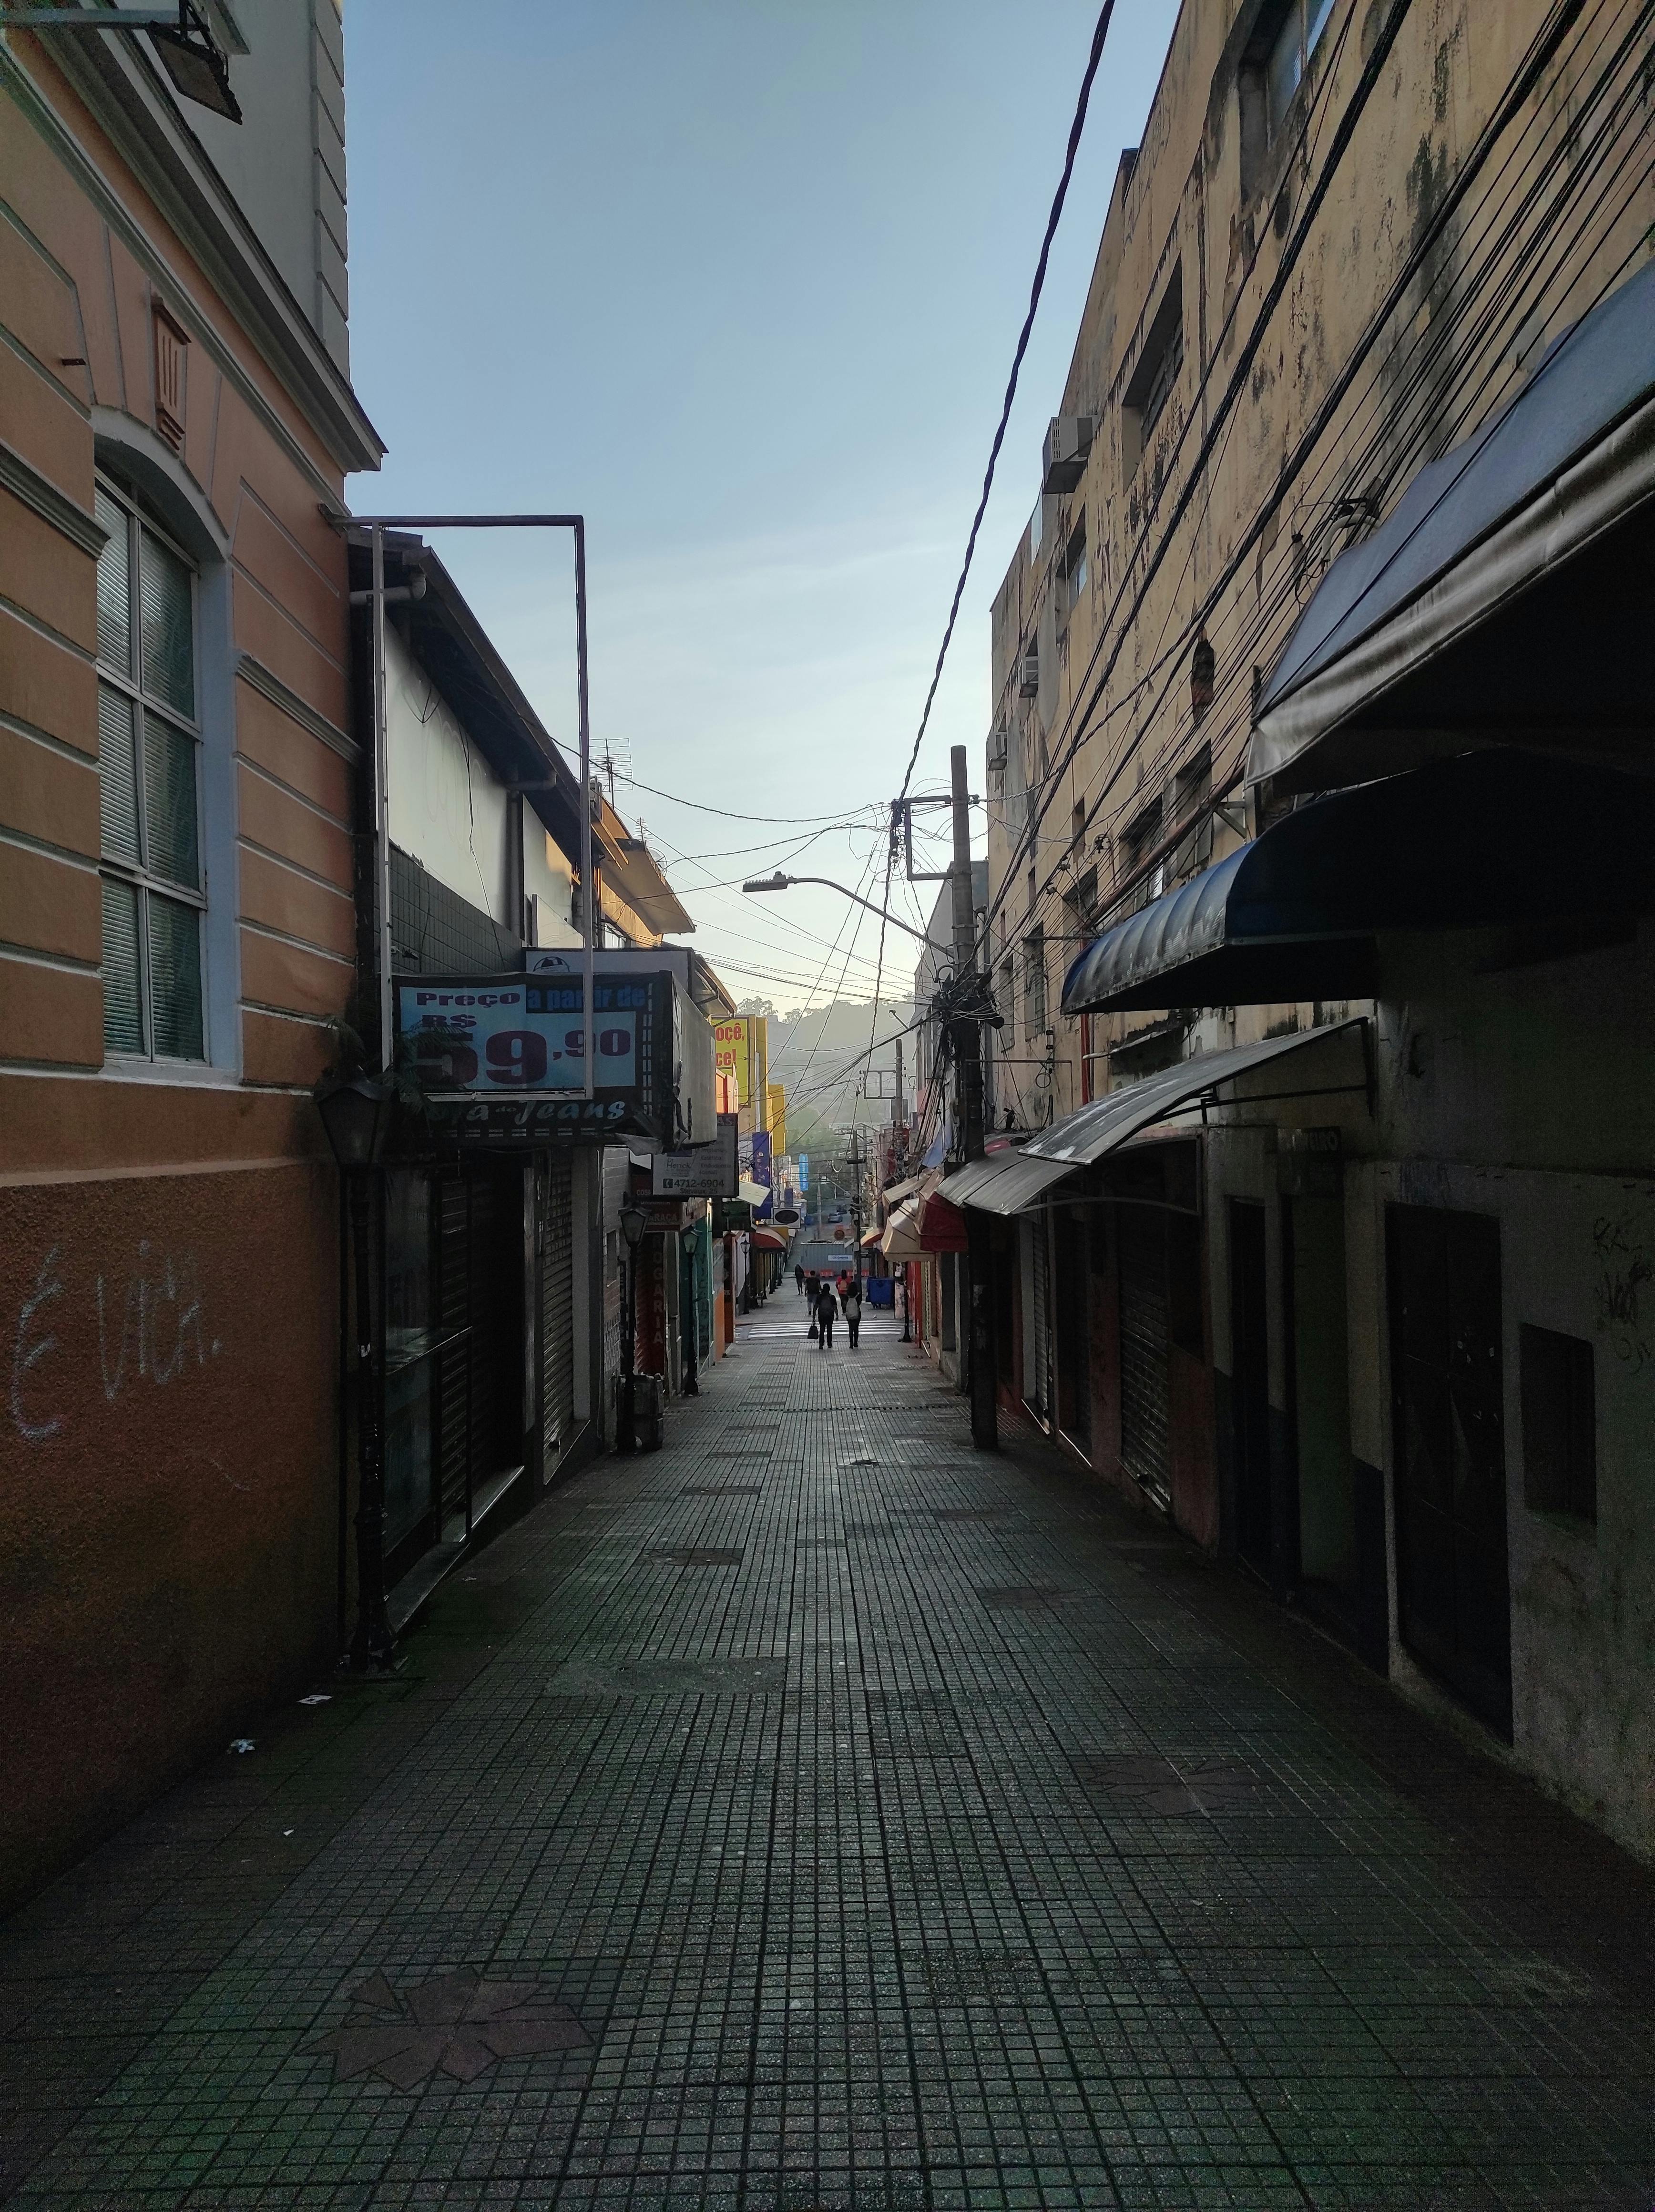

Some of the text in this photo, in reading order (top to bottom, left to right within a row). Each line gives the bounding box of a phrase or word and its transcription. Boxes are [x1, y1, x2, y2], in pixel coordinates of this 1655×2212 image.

[416, 992, 521, 1008] Preço
[528, 984, 644, 1011] a parir de
[422, 1014, 477, 1029] R$
[715, 1023, 744, 1045] oçê,
[514, 1100, 626, 1126] Jeans
[674, 1179, 724, 1188] 4712-6904
